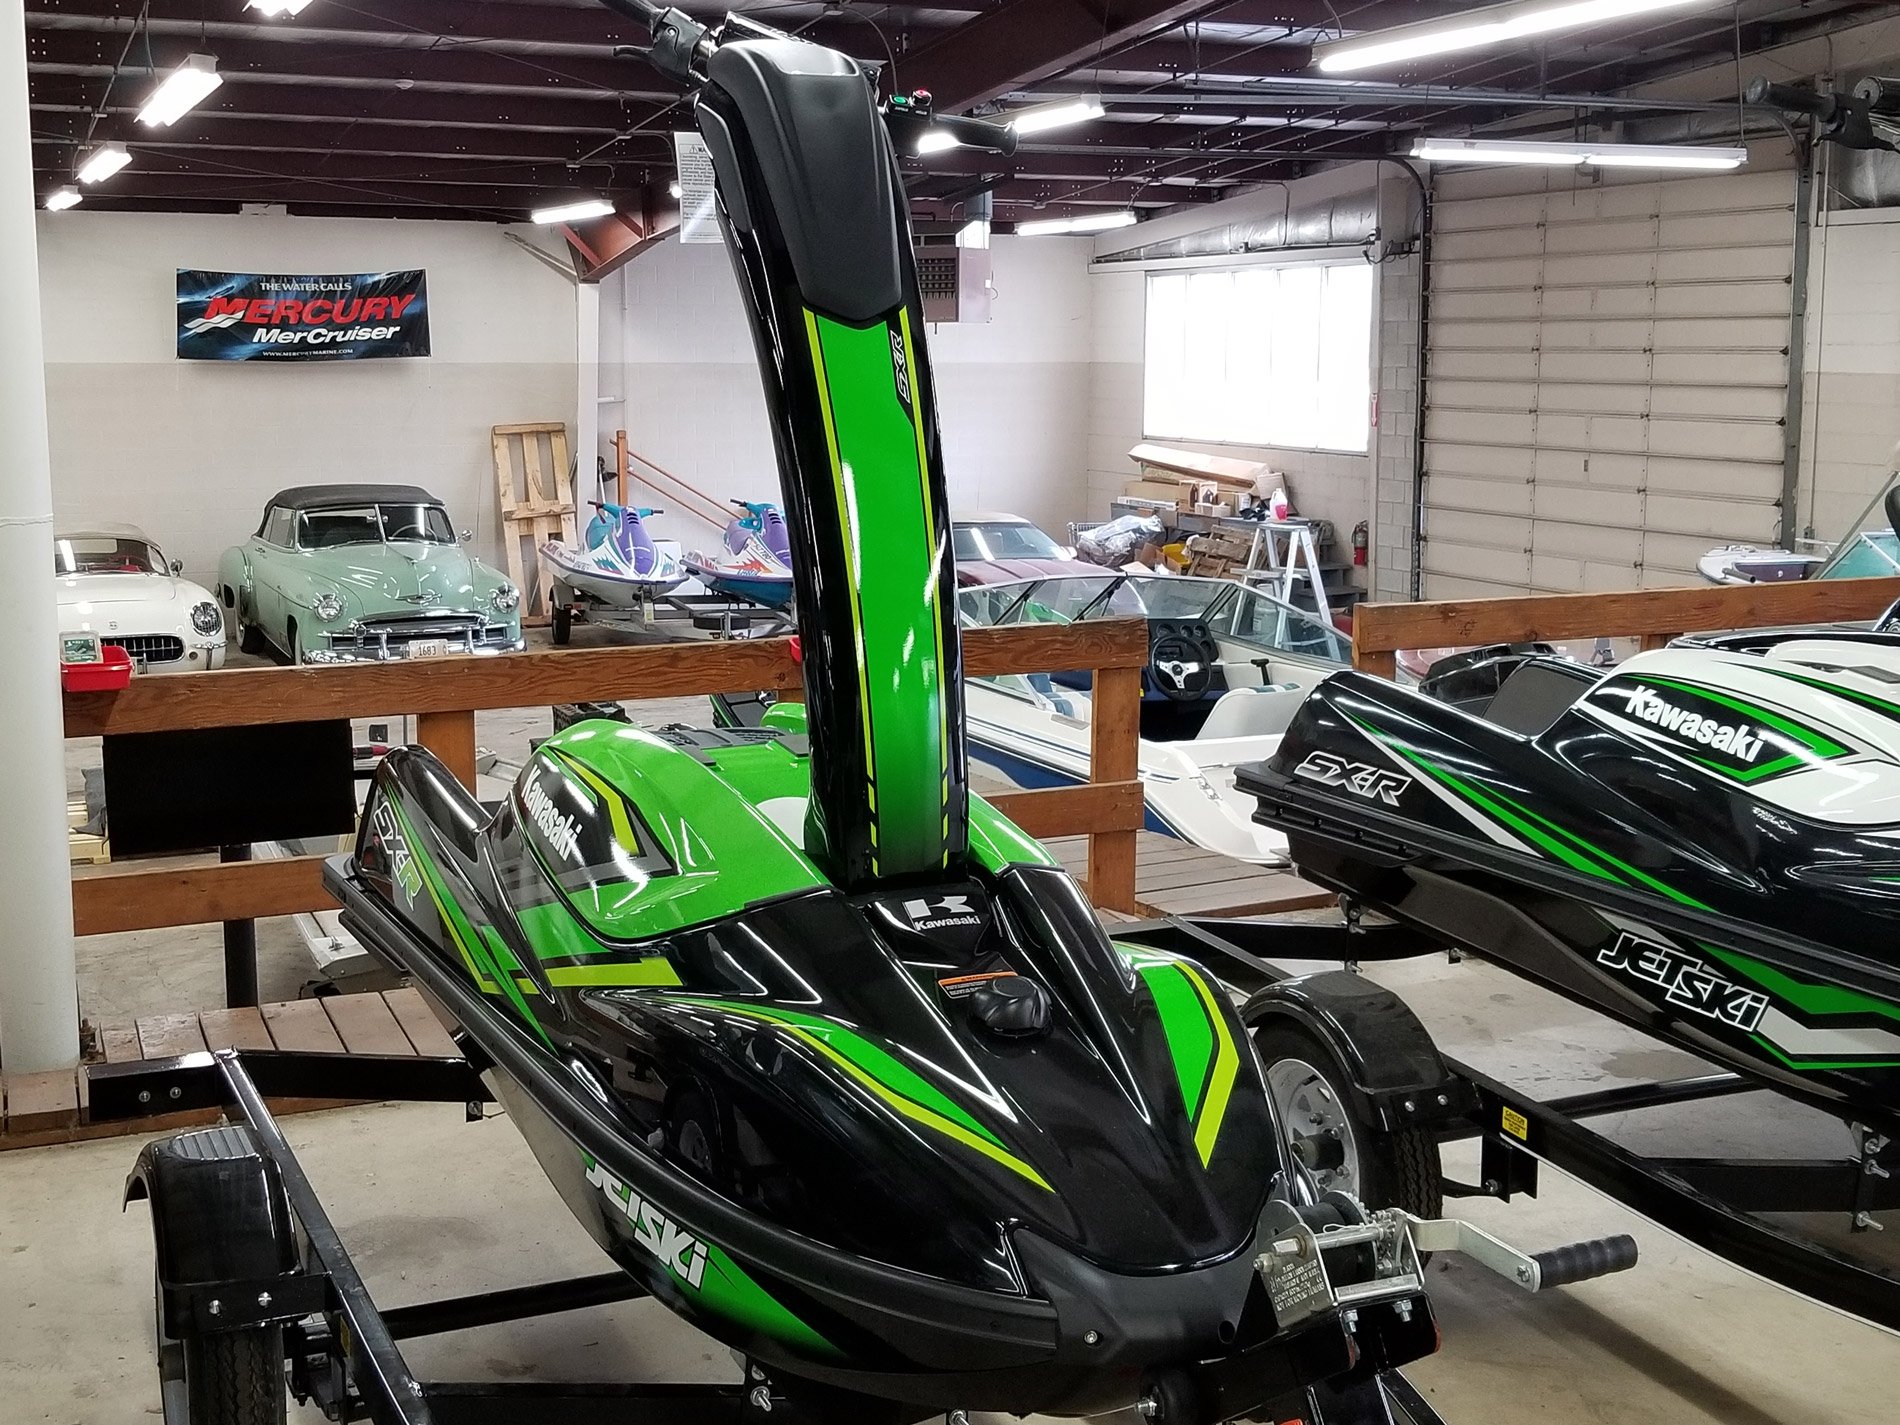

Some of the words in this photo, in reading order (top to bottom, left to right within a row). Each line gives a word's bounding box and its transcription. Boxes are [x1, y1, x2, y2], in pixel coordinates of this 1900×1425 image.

[260, 282, 281, 291] THE
[282, 283, 320, 291] WATER
[320, 282, 352, 291] CALLS
[204, 292, 416, 325] MERCURY
[252, 325, 401, 345] MerCruiser
[418, 645, 437, 656] 1683
[1624, 684, 1765, 763] Kawasaki
[520, 763, 584, 862] Kawasaki
[914, 915, 982, 931] Kawasaki
